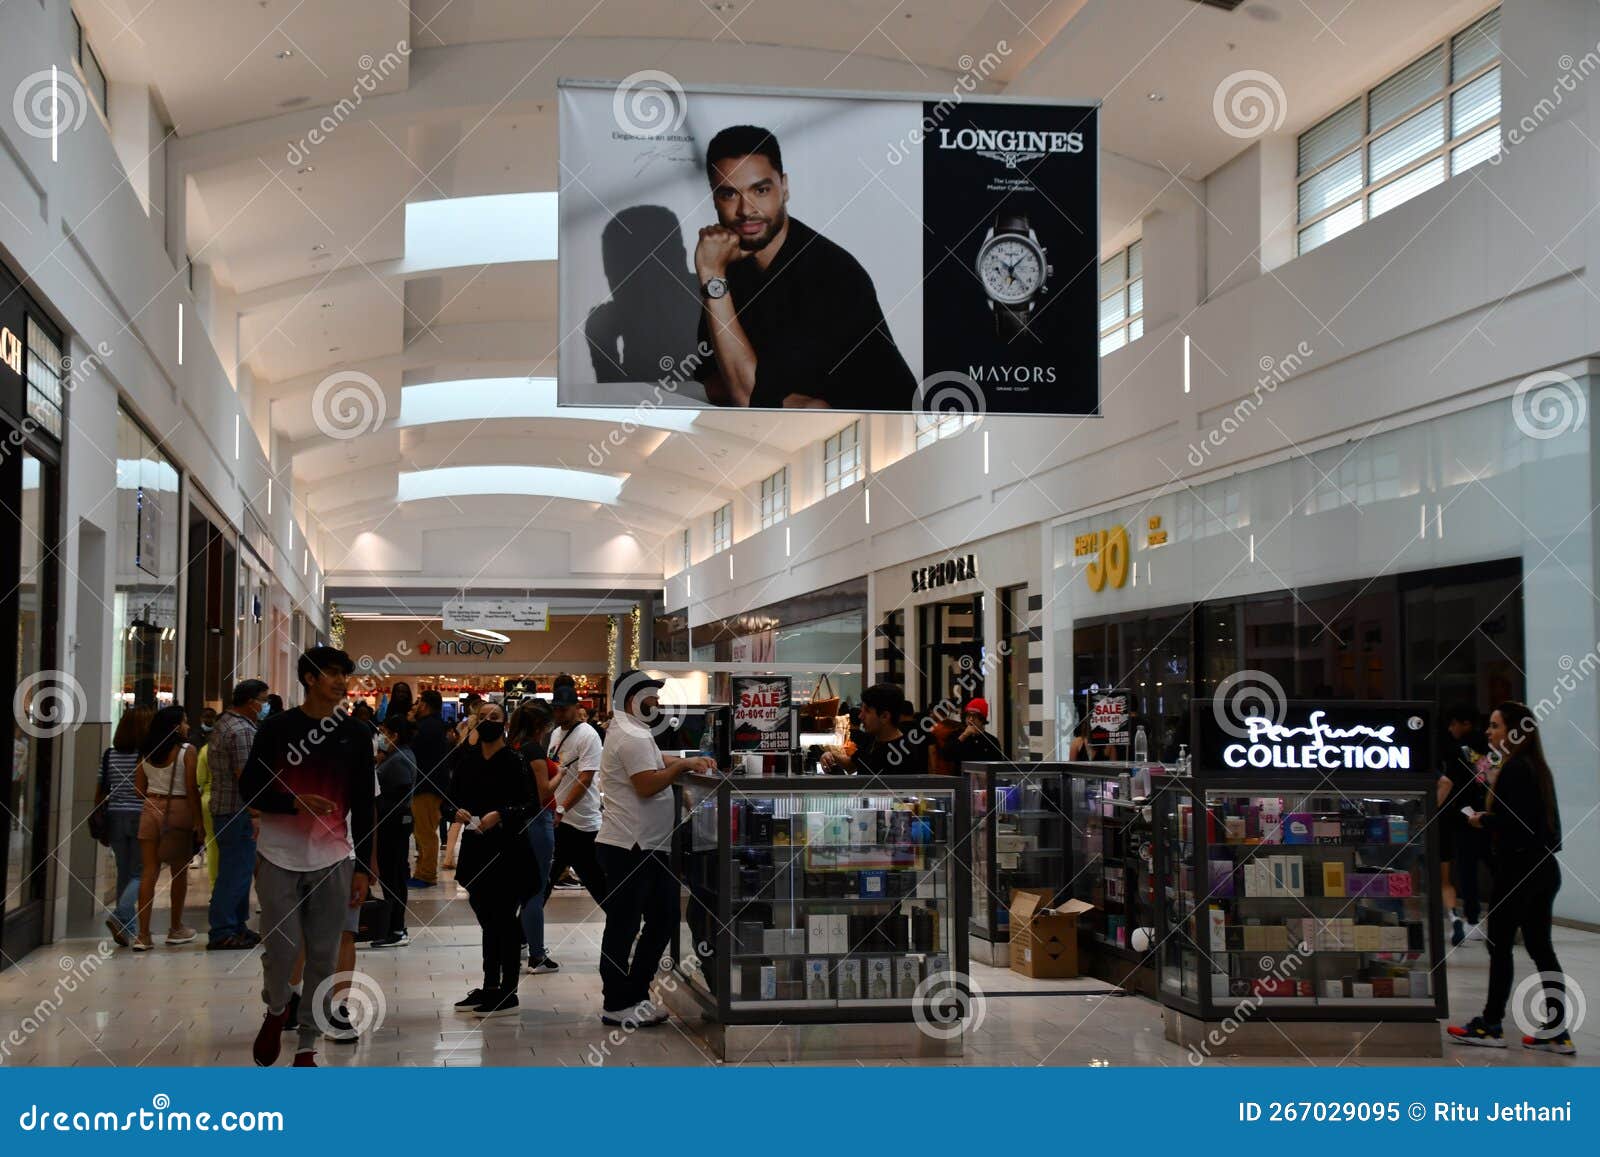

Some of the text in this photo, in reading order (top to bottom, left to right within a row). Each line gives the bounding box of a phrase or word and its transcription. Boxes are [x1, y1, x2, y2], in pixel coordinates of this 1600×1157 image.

[939, 128, 1084, 153] LONGINES
[0, 326, 22, 375] CH
[969, 365, 1056, 383] MAYORS
[1087, 525, 1129, 592] JO
[911, 554, 976, 592] SEPHORA
[741, 692, 780, 708] SALE
[1095, 704, 1121, 715] SALE
[765, 708, 777, 718] off
[1244, 710, 1396, 749] Perfume
[1223, 744, 1410, 769] COLLECTION
